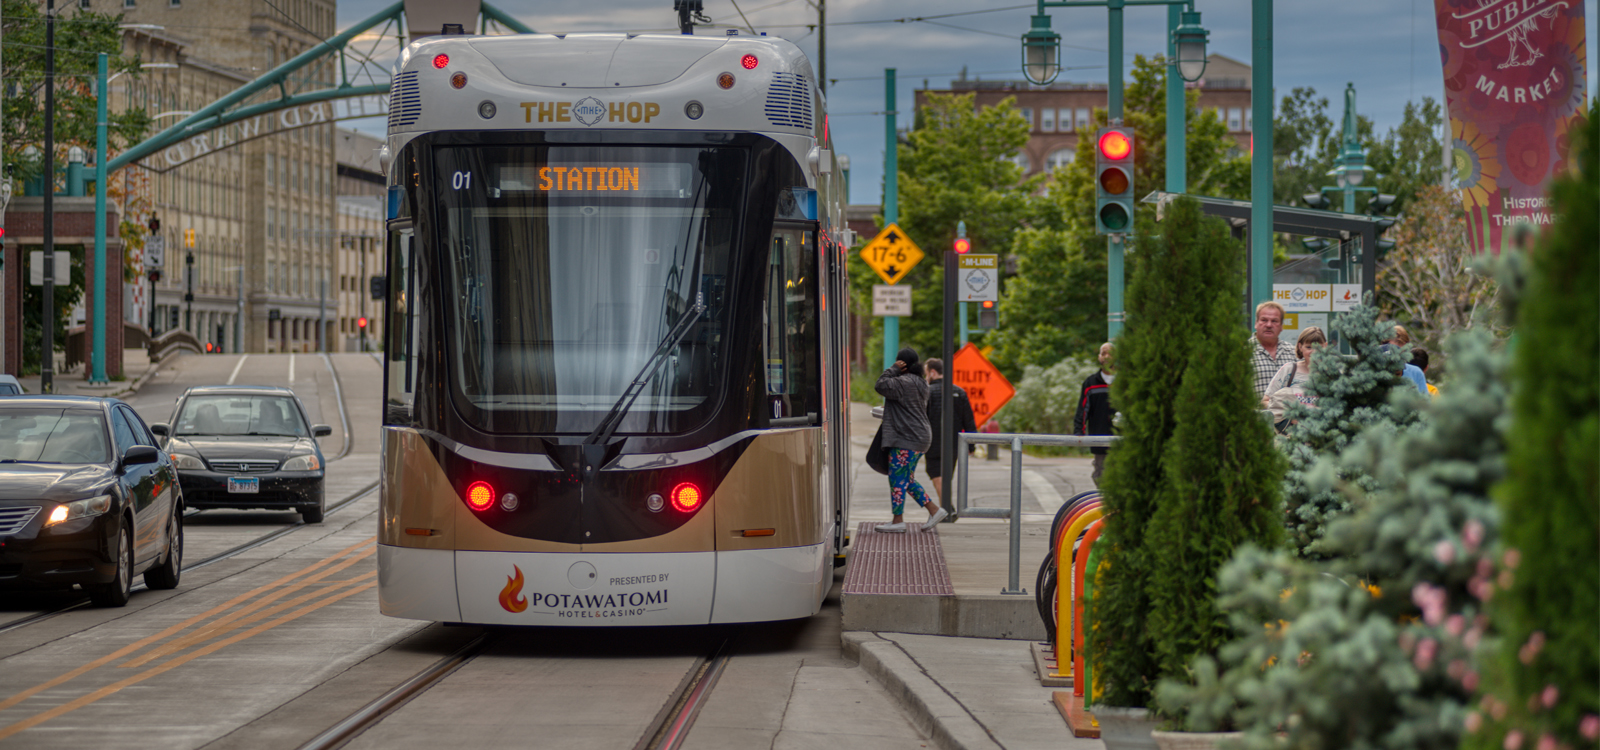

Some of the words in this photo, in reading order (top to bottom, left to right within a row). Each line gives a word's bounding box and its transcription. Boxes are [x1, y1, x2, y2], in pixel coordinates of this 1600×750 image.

[1468, 0, 1546, 39] PUBL
[1475, 67, 1559, 103] MARKET
[520, 101, 572, 123] THE
[580, 106, 598, 115] MKE
[608, 101, 660, 123] HOP
[452, 170, 471, 190] 01
[538, 166, 639, 191] STATION
[965, 258, 994, 266] M-LINE
[1306, 290, 1327, 299] HOP
[954, 370, 991, 383] TILITY
[774, 400, 781, 418] 01
[609, 575, 657, 586] PRESENTED
[658, 573, 670, 582] BY
[532, 589, 668, 609] POTAWATOMI
